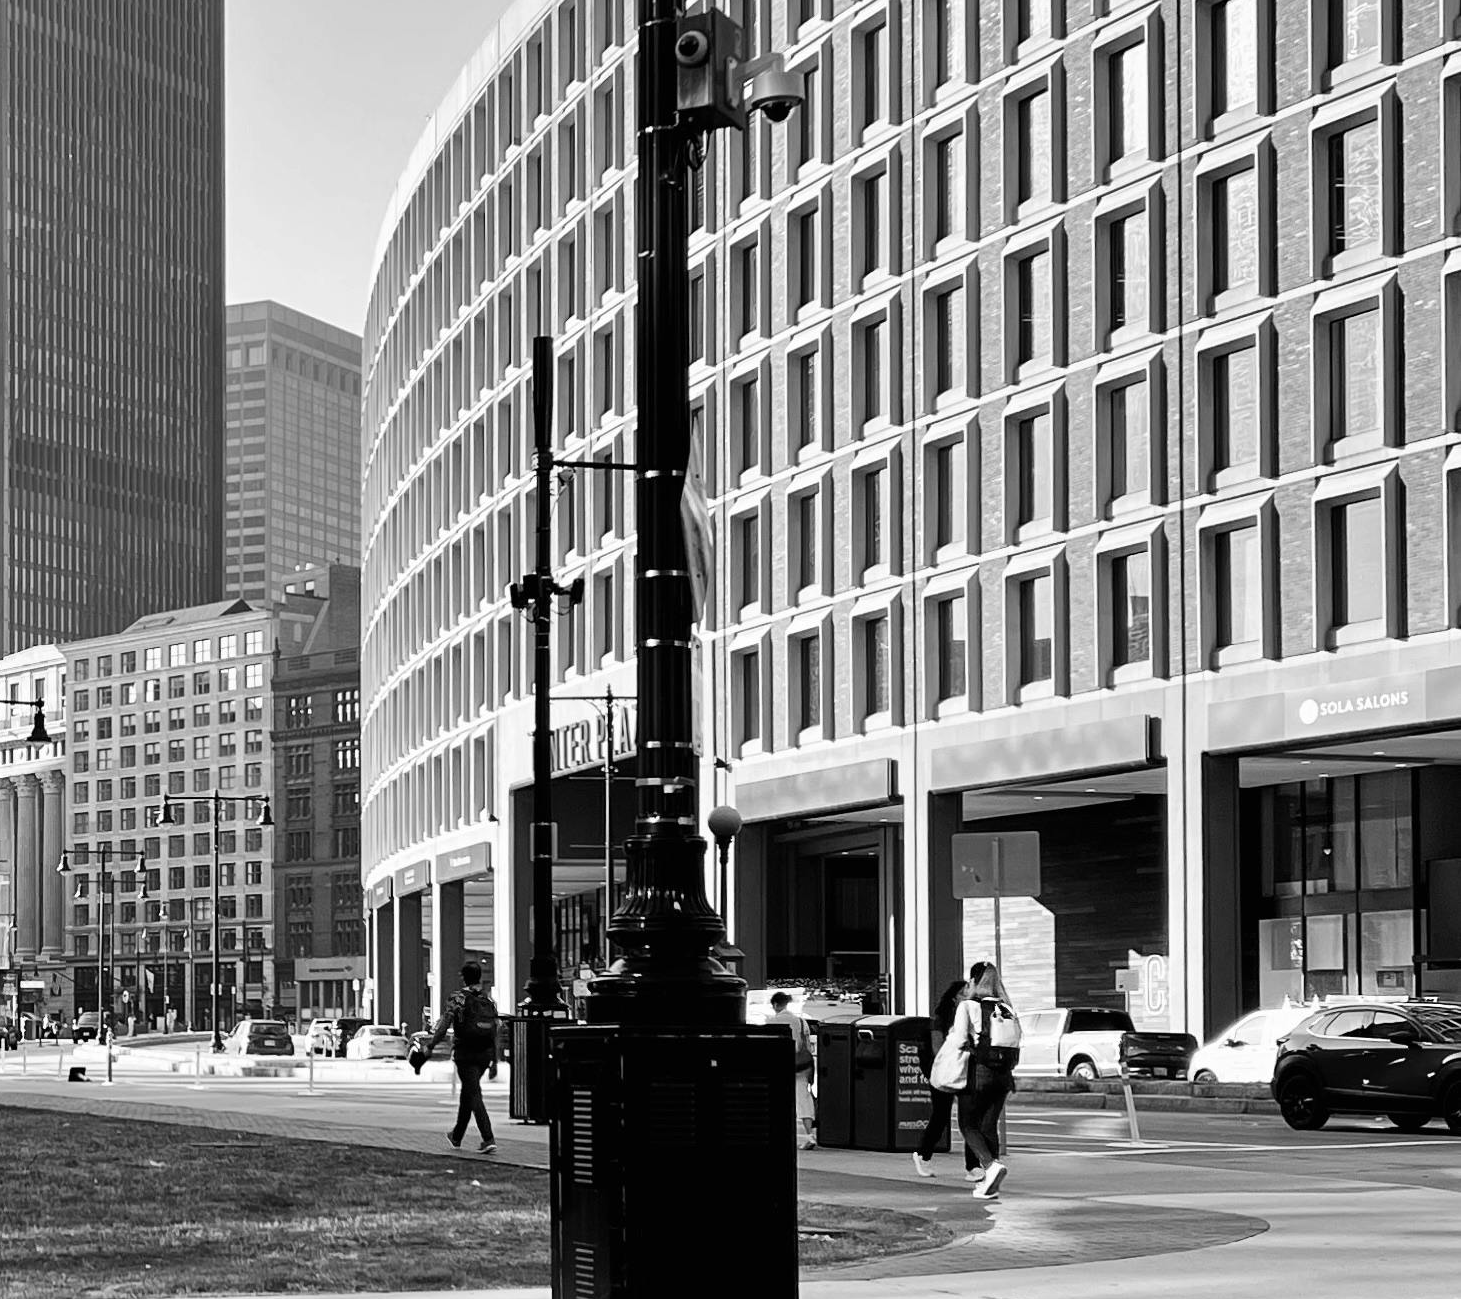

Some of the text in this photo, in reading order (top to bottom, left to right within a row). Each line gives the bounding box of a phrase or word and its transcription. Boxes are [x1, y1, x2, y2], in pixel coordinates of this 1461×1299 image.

[1320, 691, 1409, 716] SOLA SALONS
[550, 719, 595, 773] NTER
[899, 1043, 918, 1054] Sca
[899, 1055, 920, 1064] stre
[899, 1075, 918, 1084] and
